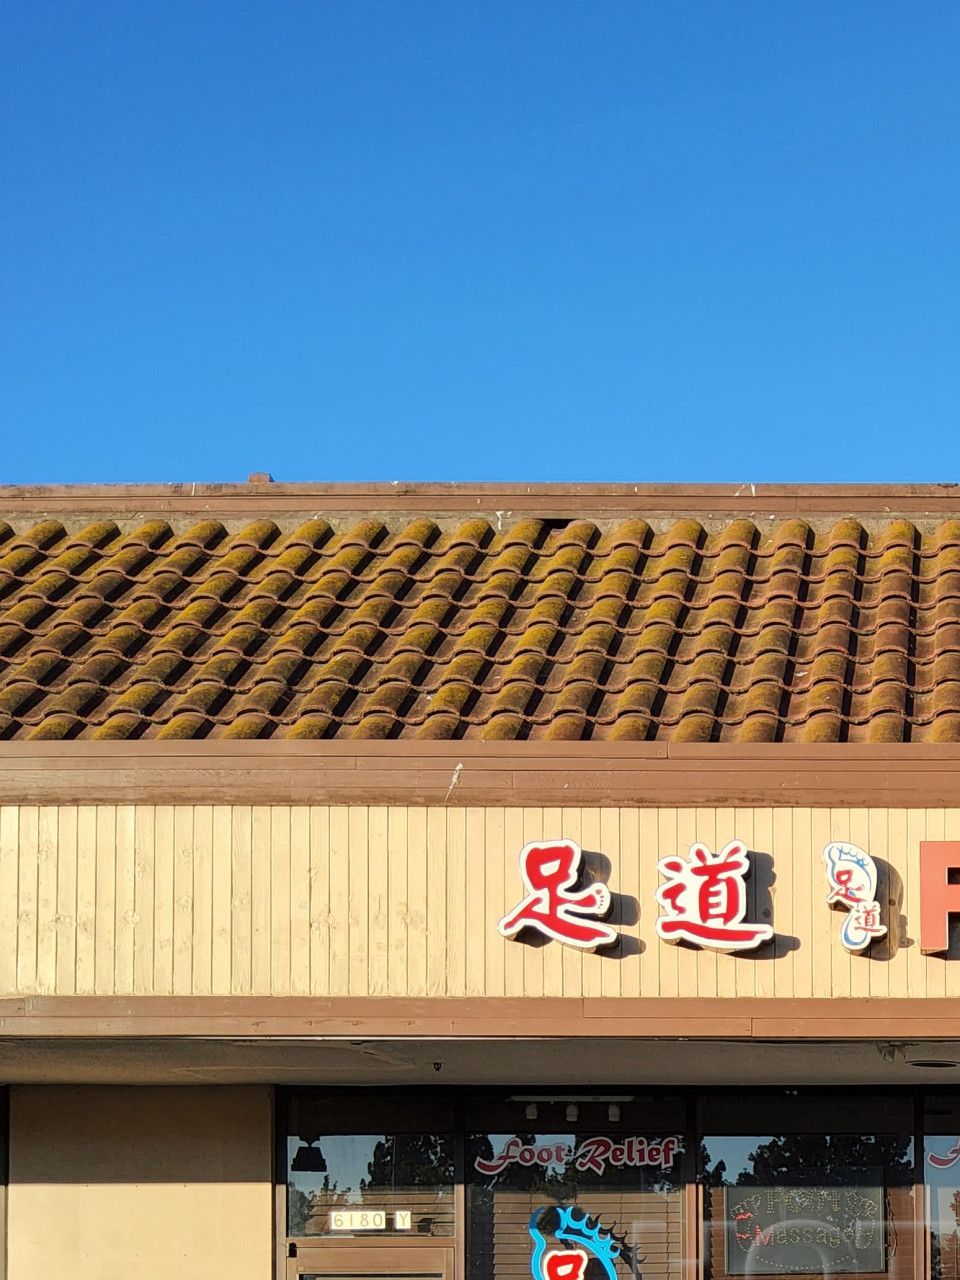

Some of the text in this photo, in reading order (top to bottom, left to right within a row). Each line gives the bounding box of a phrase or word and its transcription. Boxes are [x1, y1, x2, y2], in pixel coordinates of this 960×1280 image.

[499, 837, 773, 950] 足道
[474, 1136, 679, 1176] Foot Relief
[333, 1212, 409, 1228] 6180 Y
